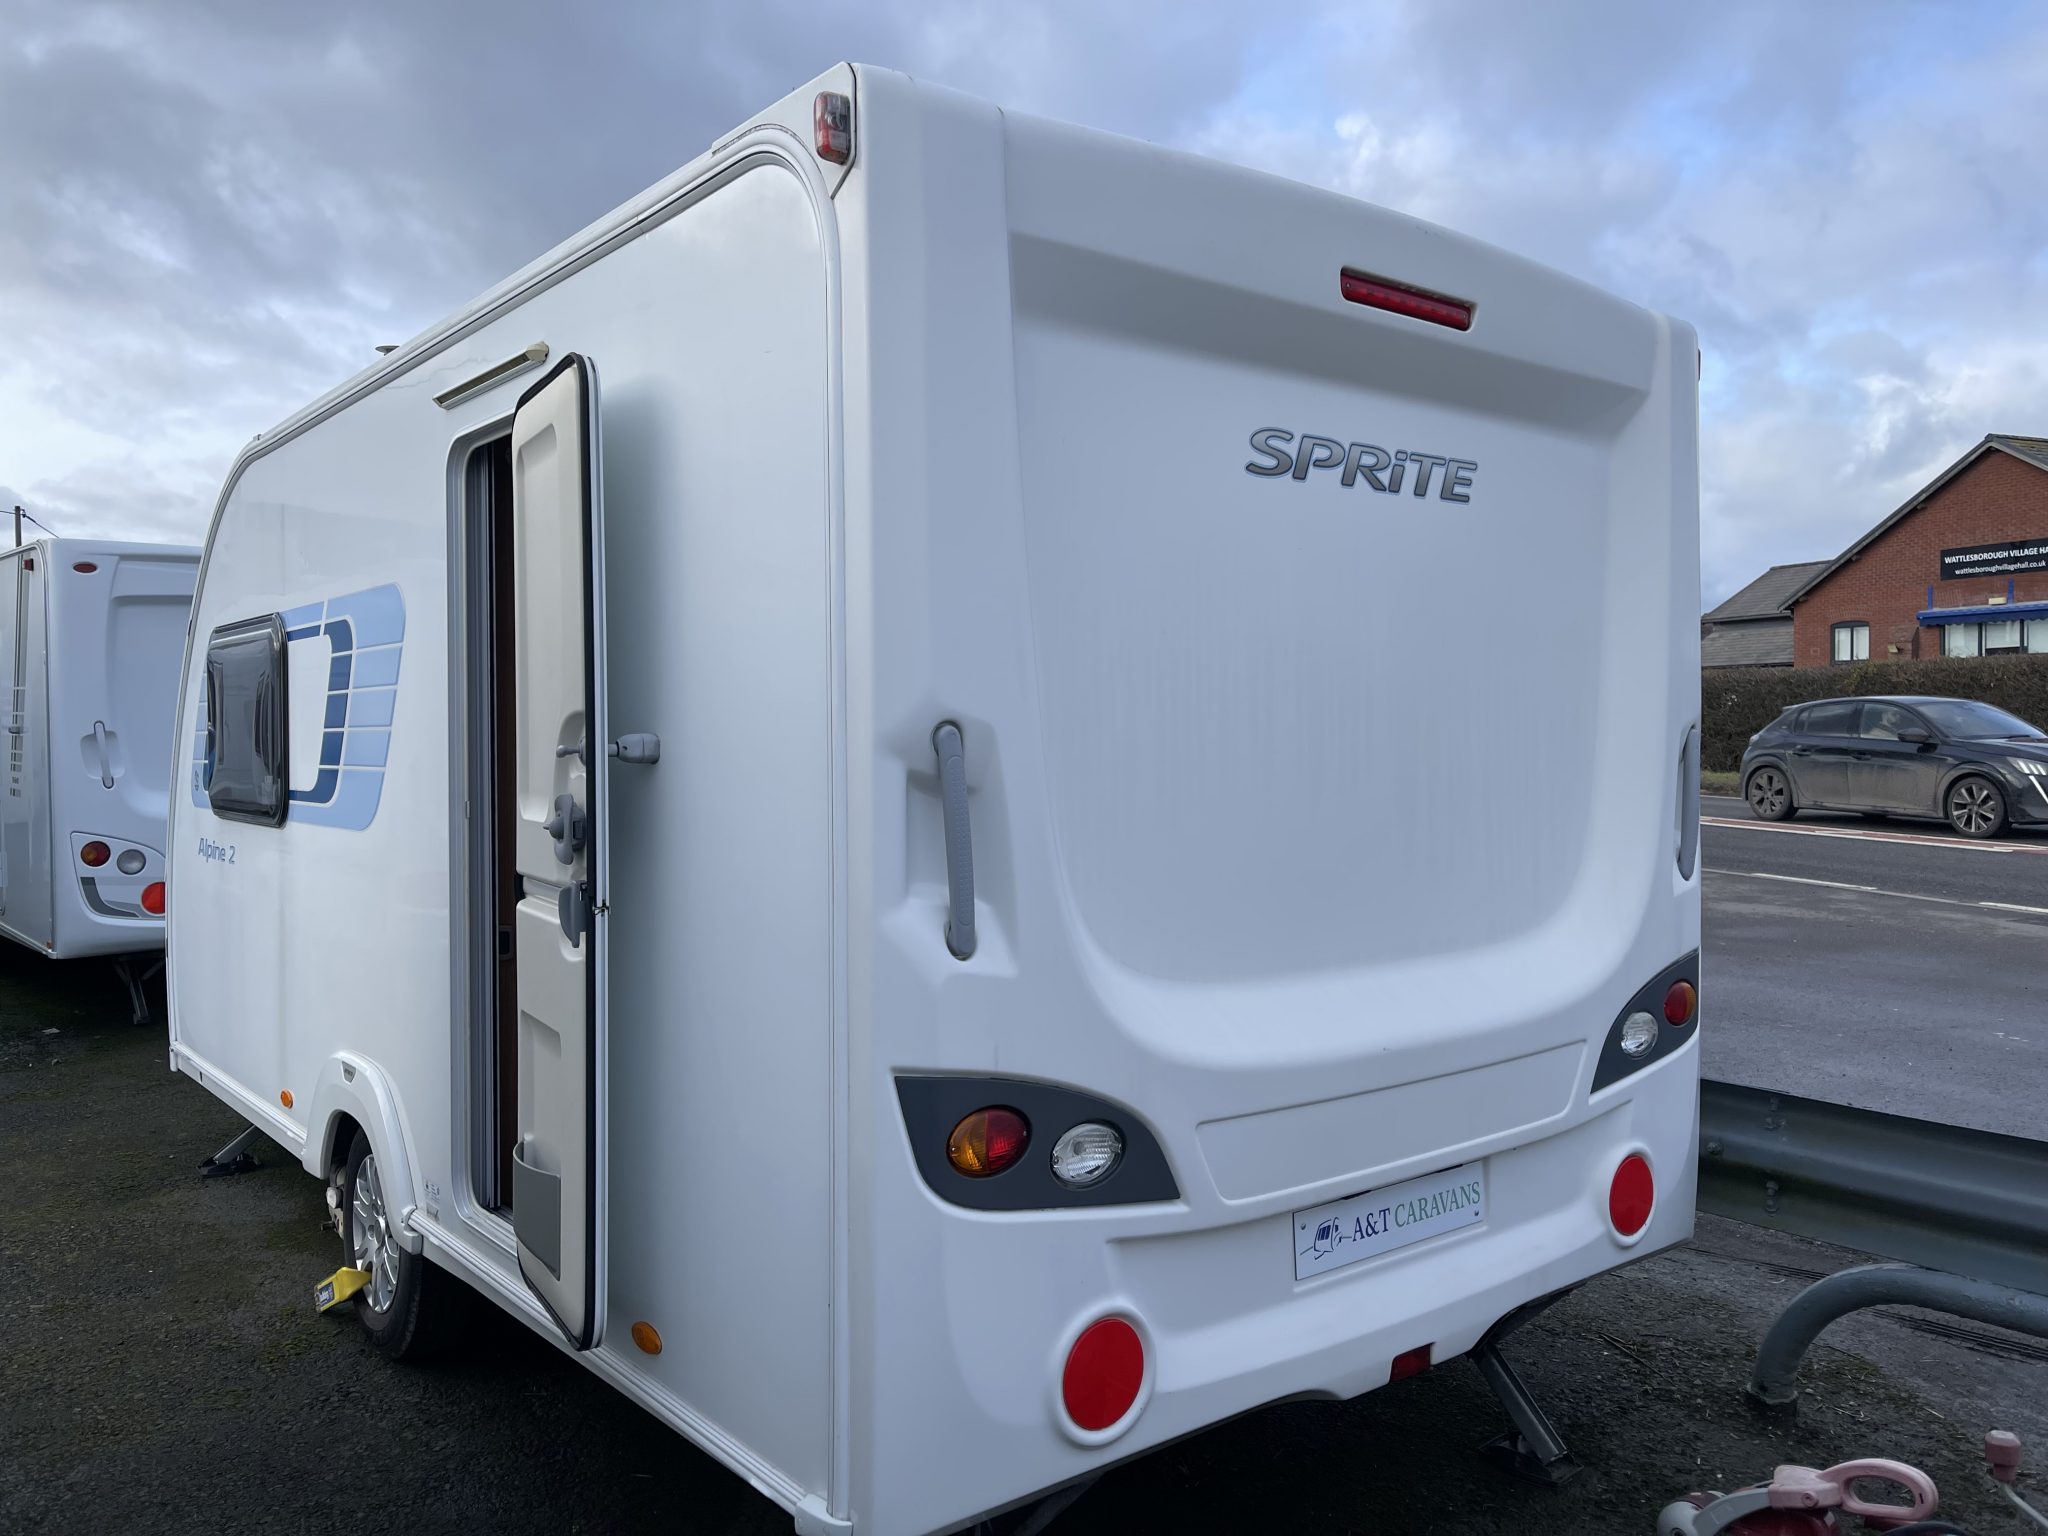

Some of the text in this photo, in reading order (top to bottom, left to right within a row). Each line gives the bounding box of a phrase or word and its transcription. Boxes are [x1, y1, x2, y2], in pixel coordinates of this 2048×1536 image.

[1944, 551, 2009, 564] WATTLESBOROUGH
[2009, 547, 2038, 557] VILLAGE
[1955, 560, 2047, 575] wattlesboroughvillagehall.co.uk
[198, 837, 236, 865] Alpine 2
[1352, 1181, 1481, 1242] A&T CARAVANS
